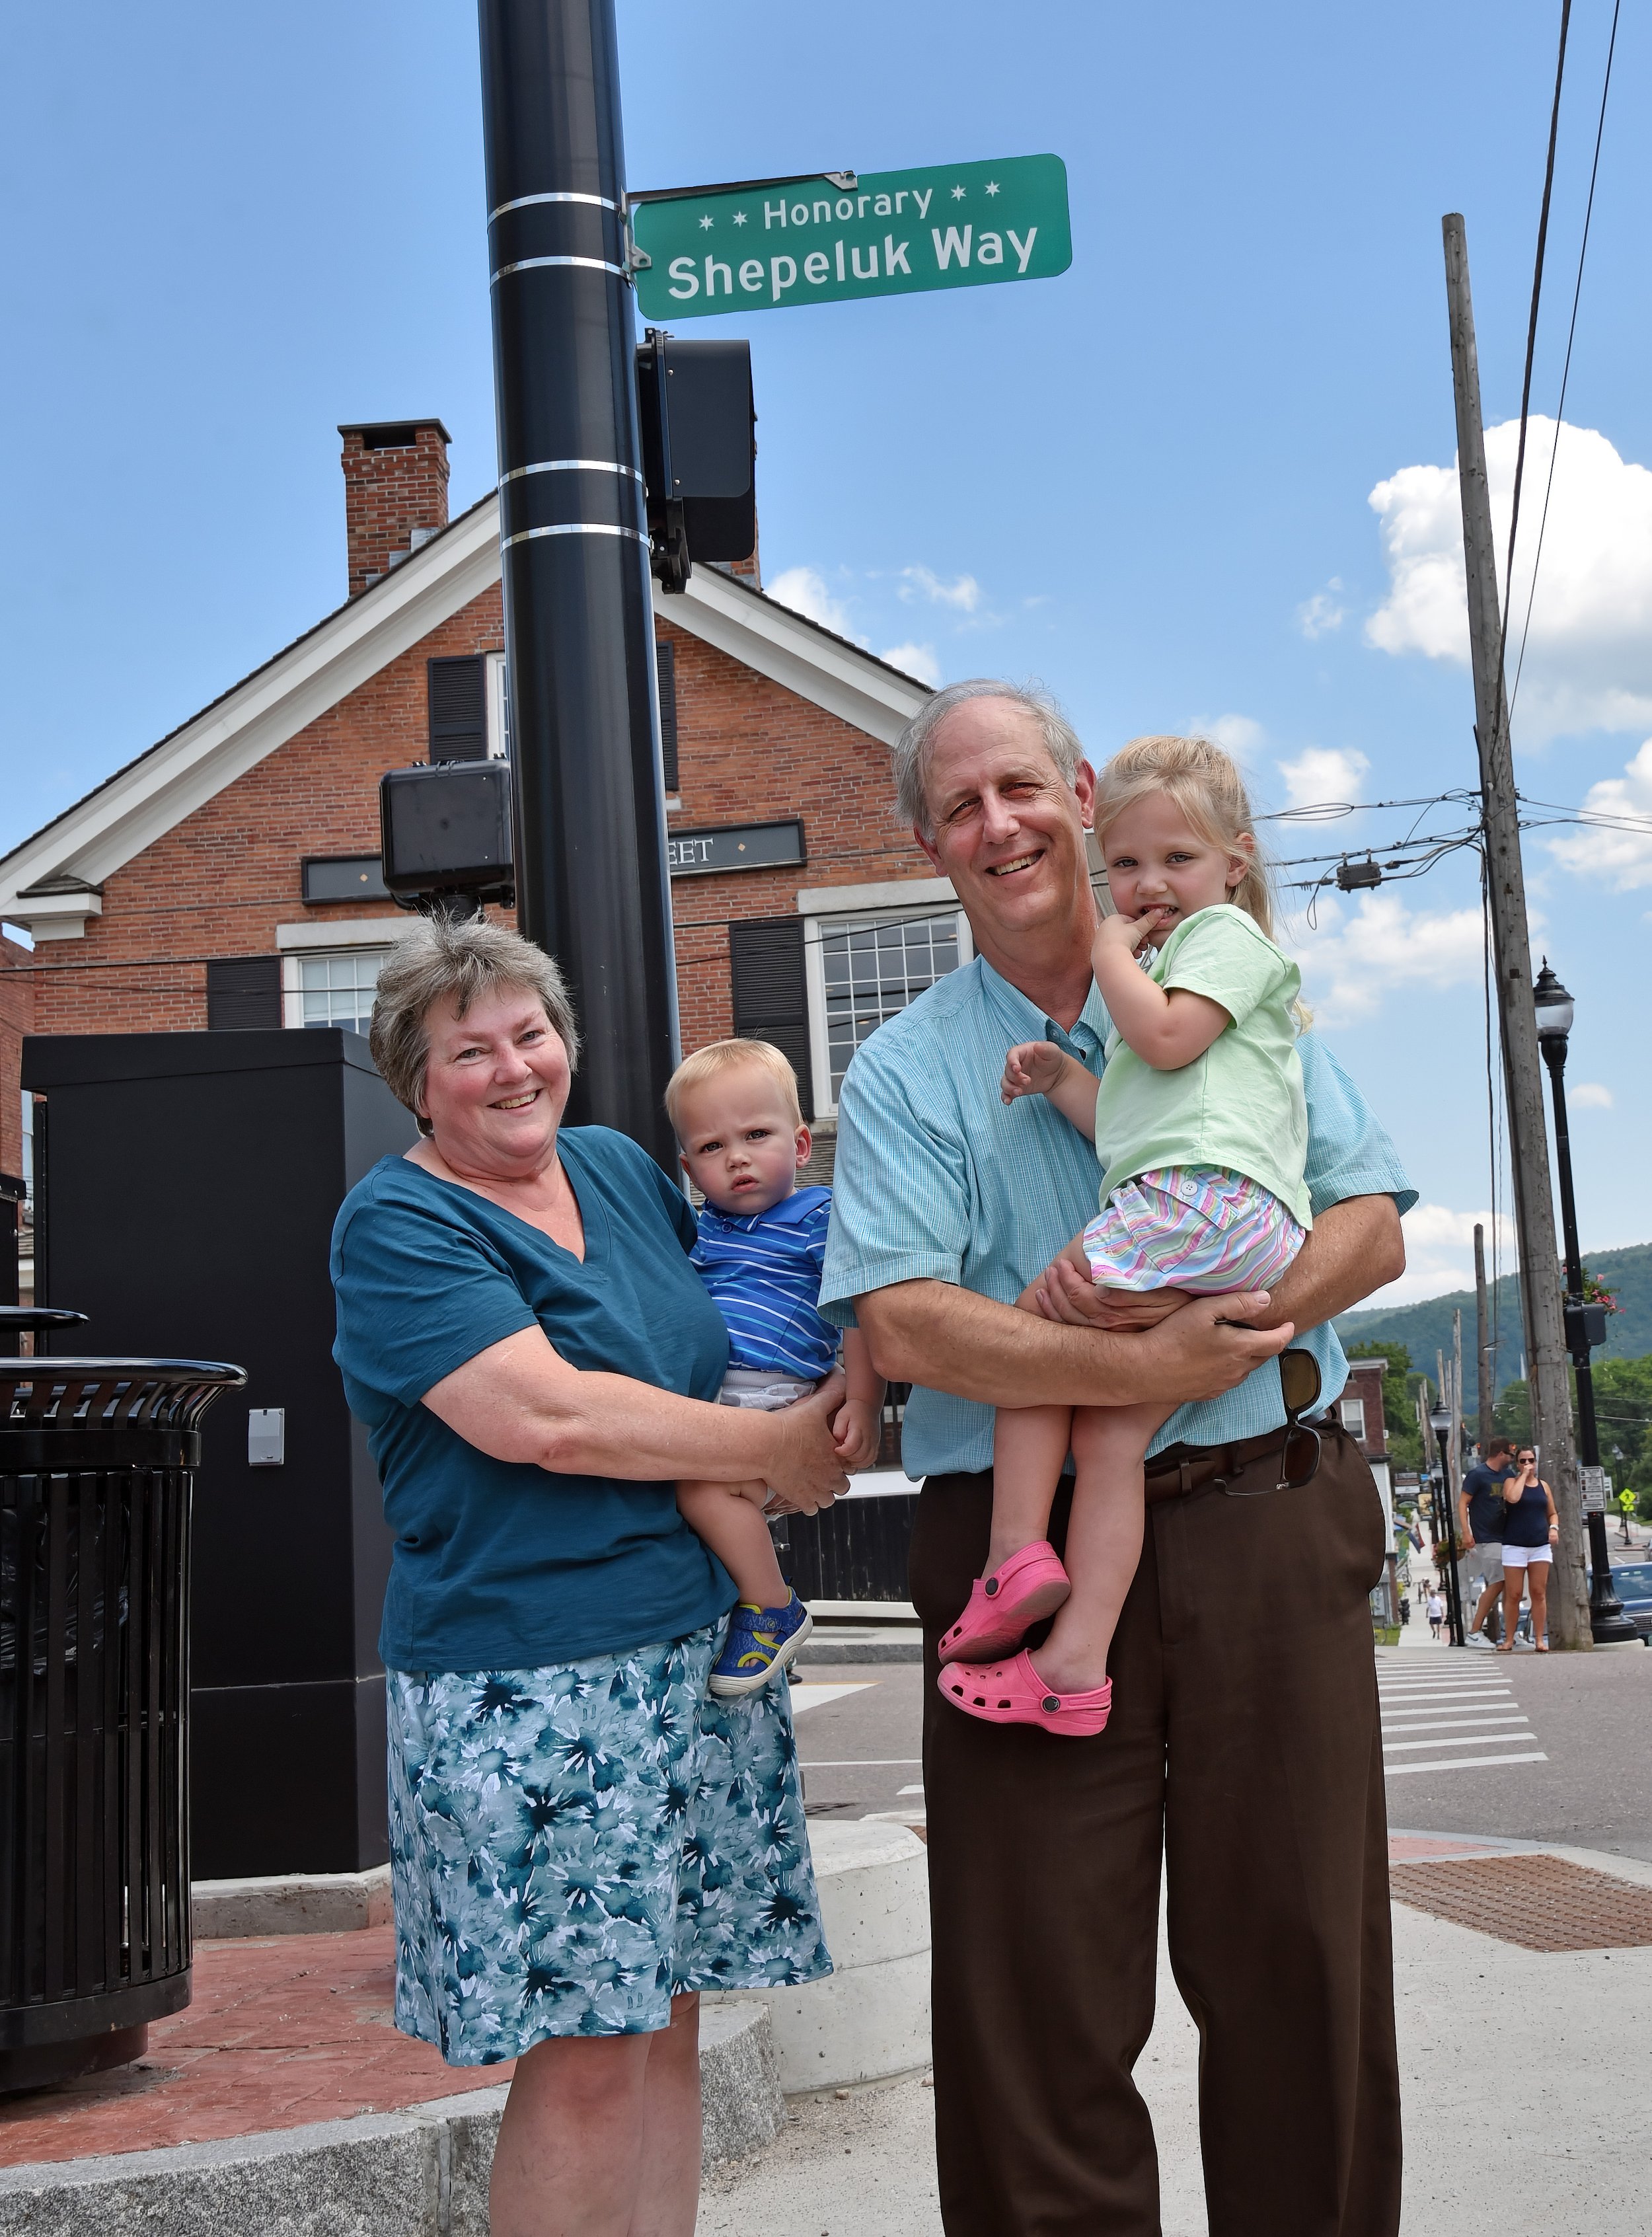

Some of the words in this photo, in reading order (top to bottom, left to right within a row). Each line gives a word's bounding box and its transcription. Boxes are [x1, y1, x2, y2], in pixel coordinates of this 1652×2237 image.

[764, 188, 933, 230] Honorary
[668, 234, 912, 302] Shepeluk
[931, 224, 1038, 273] Way
